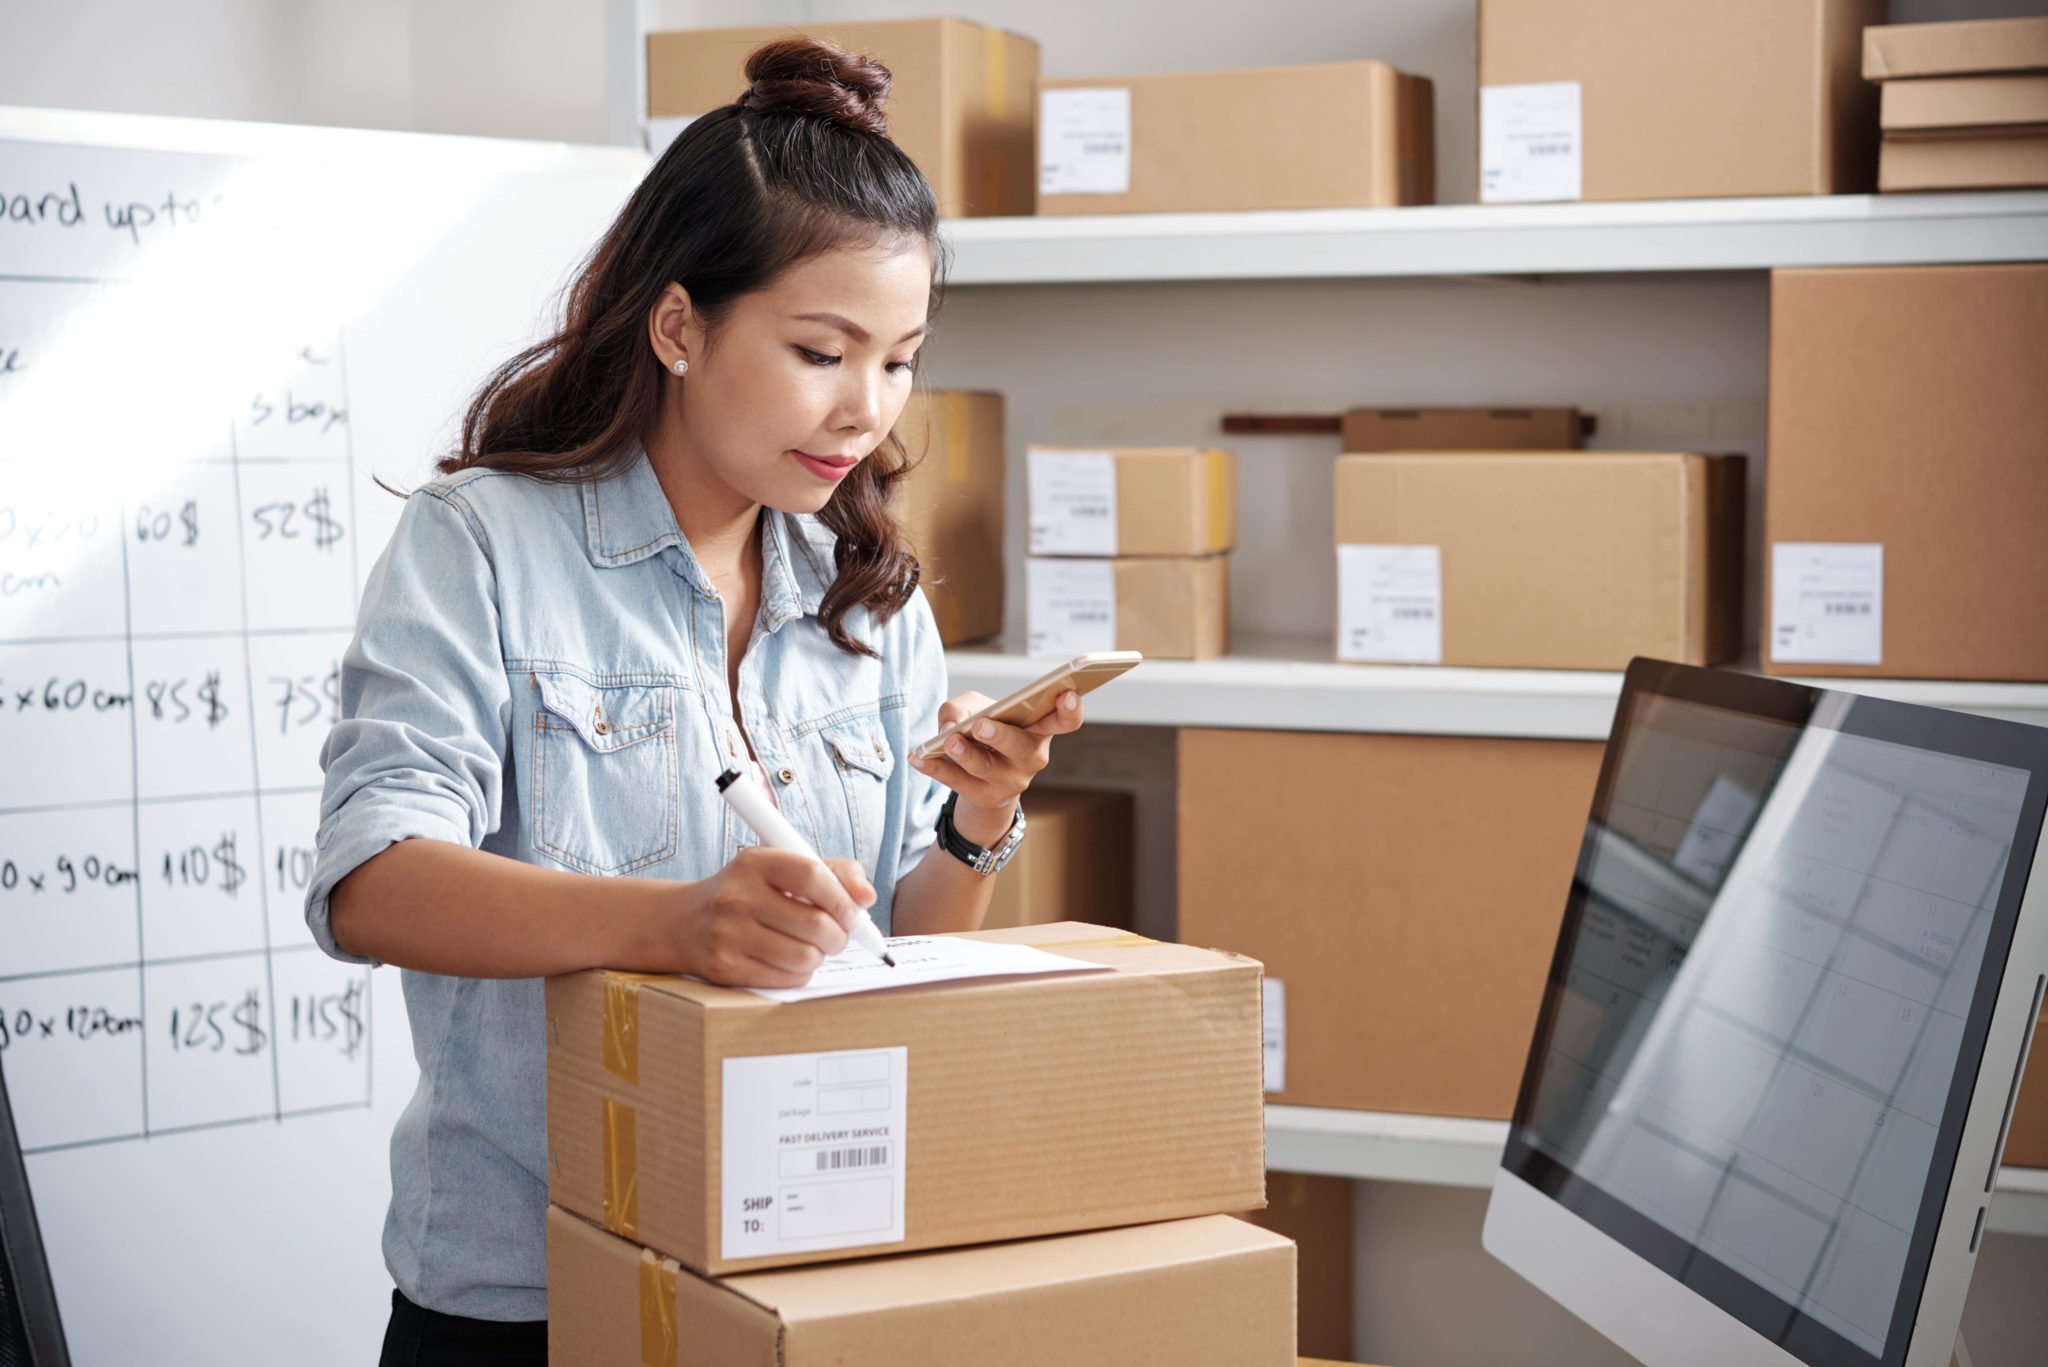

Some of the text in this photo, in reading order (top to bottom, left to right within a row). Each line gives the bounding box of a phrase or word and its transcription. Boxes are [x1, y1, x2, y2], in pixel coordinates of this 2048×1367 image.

[137, 500, 200, 547] 60$
[252, 486, 345, 554] 52$
[146, 669, 229, 730] 85$
[162, 830, 246, 899] 110$
[170, 988, 267, 1057] 125$
[291, 978, 366, 1062] 115$
[779, 1126, 889, 1144] FAST DELIVERY SERVICE
[743, 1196, 773, 1211] SHIP
[743, 1219, 765, 1233] TO:
